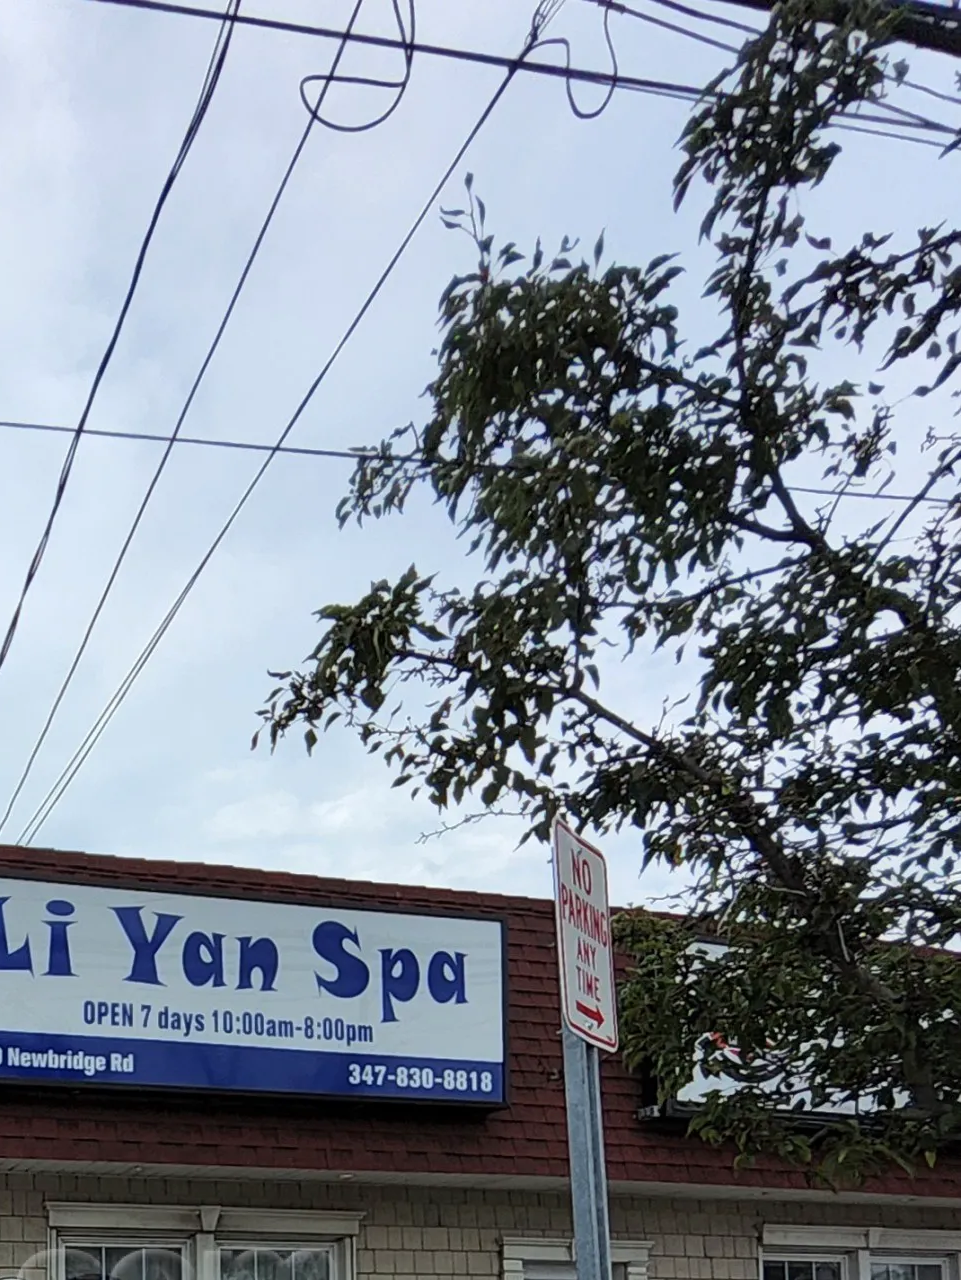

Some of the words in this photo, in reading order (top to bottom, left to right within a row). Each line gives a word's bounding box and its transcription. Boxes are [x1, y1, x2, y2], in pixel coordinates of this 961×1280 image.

[571, 848, 592, 896] NO
[560, 882, 608, 947] PARKING
[107, 905, 278, 991] Yan
[312, 920, 468, 1023] Spa
[576, 937, 596, 970] ANY
[575, 965, 601, 1002] TIME
[83, 1000, 134, 1028] OPEN
[141, 1004, 152, 1028] 7
[158, 1006, 205, 1037] days
[212, 1009, 374, 1046] 10:00am-8:00pm
[7, 1047, 107, 1076] Newbridge
[110, 1053, 134, 1073] Rd
[348, 1063, 493, 1092] 347-830-8818
